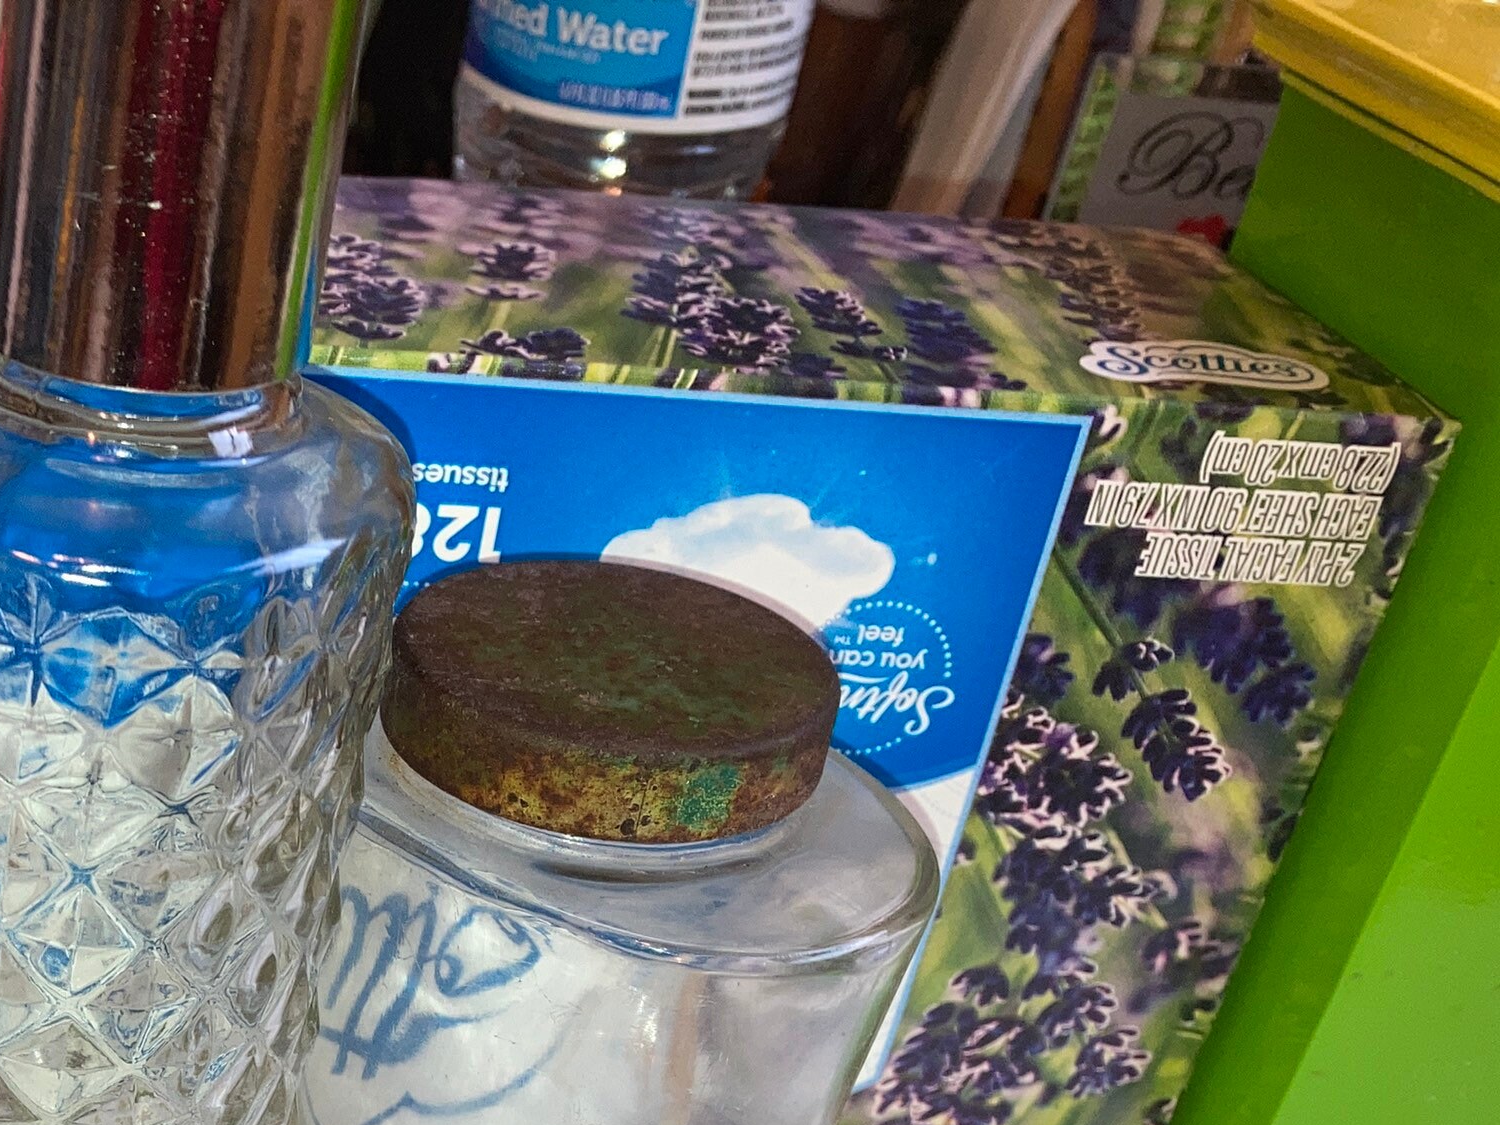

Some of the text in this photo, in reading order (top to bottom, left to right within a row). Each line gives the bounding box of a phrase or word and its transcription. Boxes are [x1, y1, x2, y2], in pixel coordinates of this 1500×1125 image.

[556, 6, 670, 56] Water
[1096, 345, 1298, 378] Scotties
[411, 462, 509, 493] tissues
[1200, 430, 1253, 484] cm)
[1245, 438, 1286, 486] 20
[1299, 442, 1343, 480] cm
[1084, 480, 1125, 527] IN
[1114, 482, 1160, 529] 7.9
[1170, 484, 1210, 532] IN
[1201, 487, 1248, 533] 9.0
[1237, 489, 1320, 537] SHEET
[1310, 492, 1384, 540] EACH
[1134, 532, 1368, 587] 2-PLY FACIAL TISSUE
[828, 648, 929, 670] you can
[856, 623, 905, 648] feel
